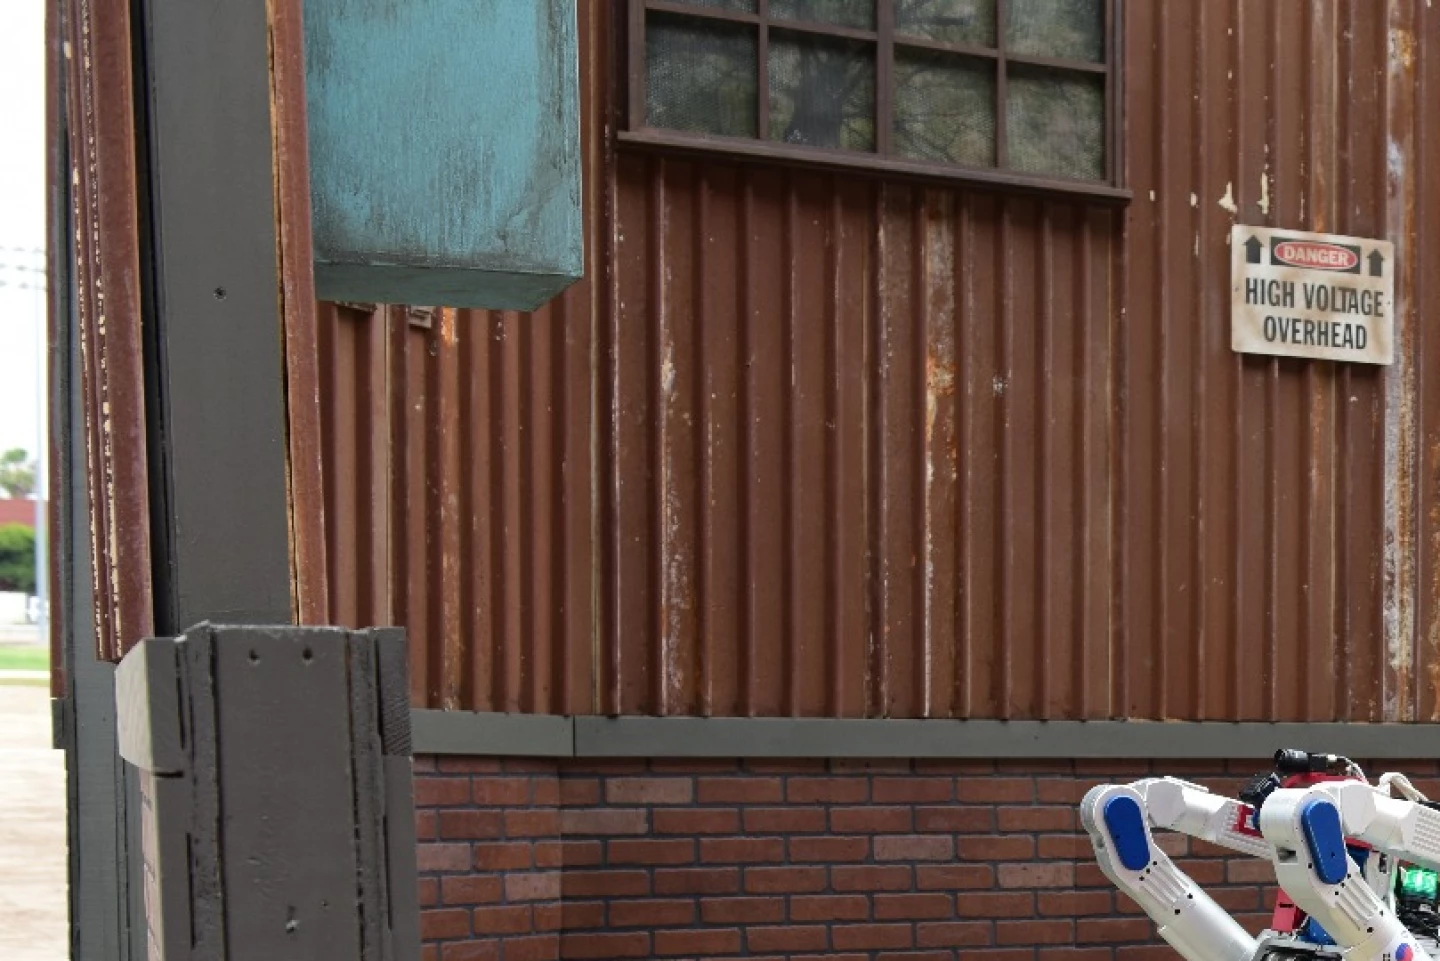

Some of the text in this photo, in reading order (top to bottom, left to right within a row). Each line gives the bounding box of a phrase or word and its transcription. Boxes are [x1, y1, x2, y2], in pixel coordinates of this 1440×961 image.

[1283, 245, 1349, 267] DANGER
[1245, 277, 1384, 318] HIGH VOLTAGE
[1263, 315, 1368, 350] OVERHEAD
